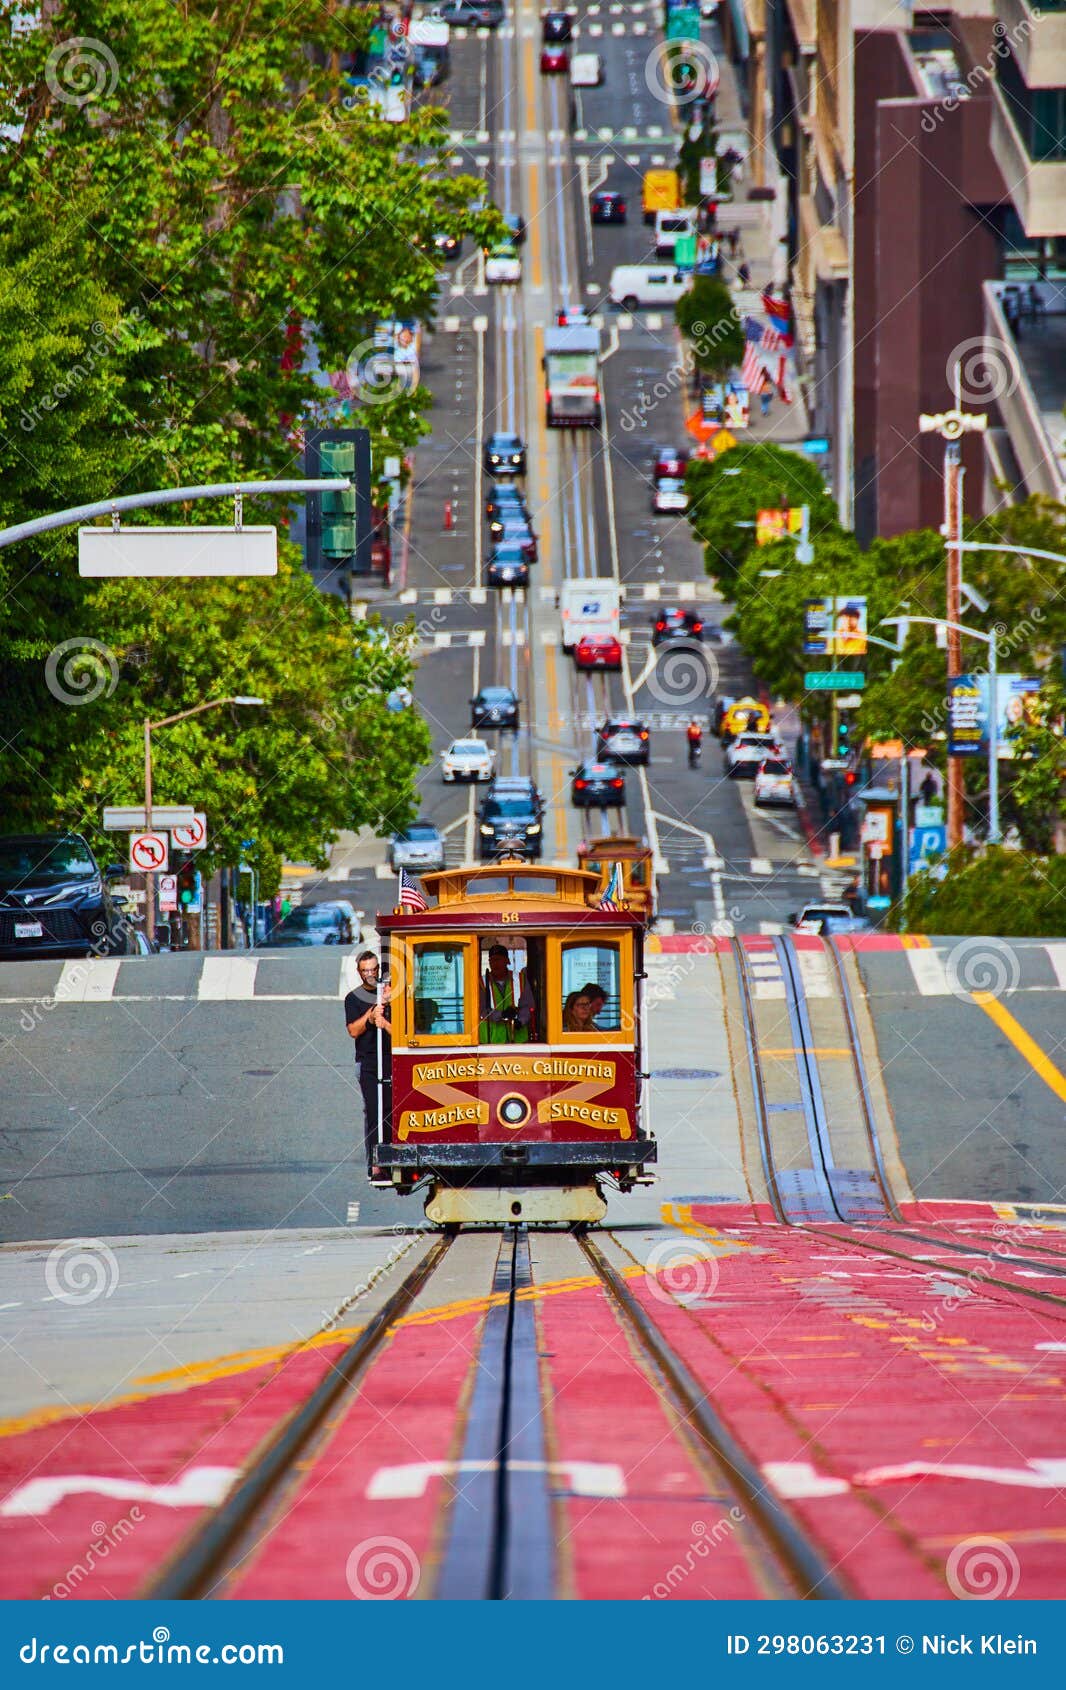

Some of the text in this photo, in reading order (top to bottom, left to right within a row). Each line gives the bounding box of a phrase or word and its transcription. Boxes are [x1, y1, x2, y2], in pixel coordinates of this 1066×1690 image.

[502, 911, 520, 923] 56
[416, 1066, 444, 1082] Van
[446, 1061, 485, 1080] Ness
[533, 1060, 613, 1079] California
[408, 1102, 619, 1127] & Market Streets
